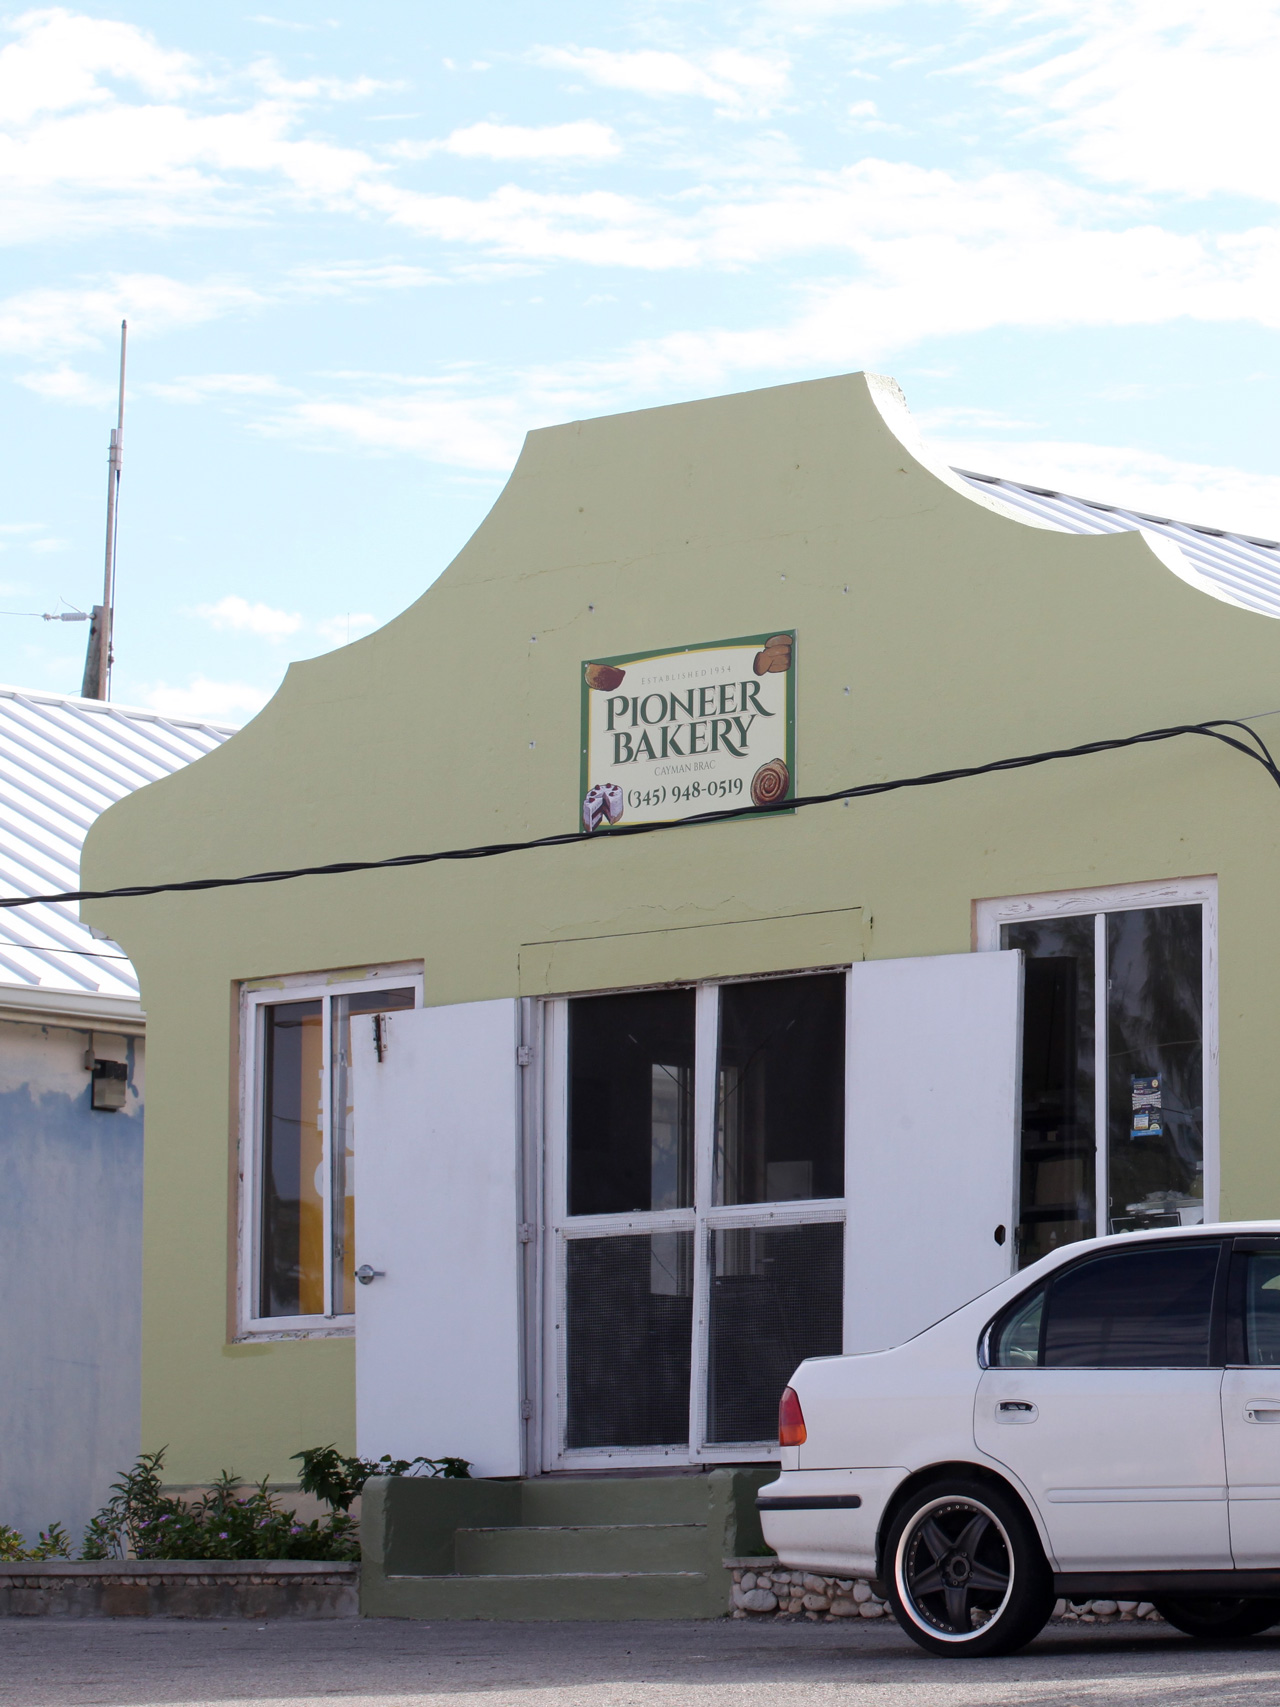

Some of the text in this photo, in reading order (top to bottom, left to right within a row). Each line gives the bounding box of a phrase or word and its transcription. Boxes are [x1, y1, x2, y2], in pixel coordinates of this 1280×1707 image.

[641, 669, 707, 685] ESTABLISHED
[605, 680, 776, 732] PIONEER
[611, 714, 755, 766] BAKERY
[654, 760, 716, 776] CAYMAN BRAC
[627, 777, 743, 808] (345) 948-0519
